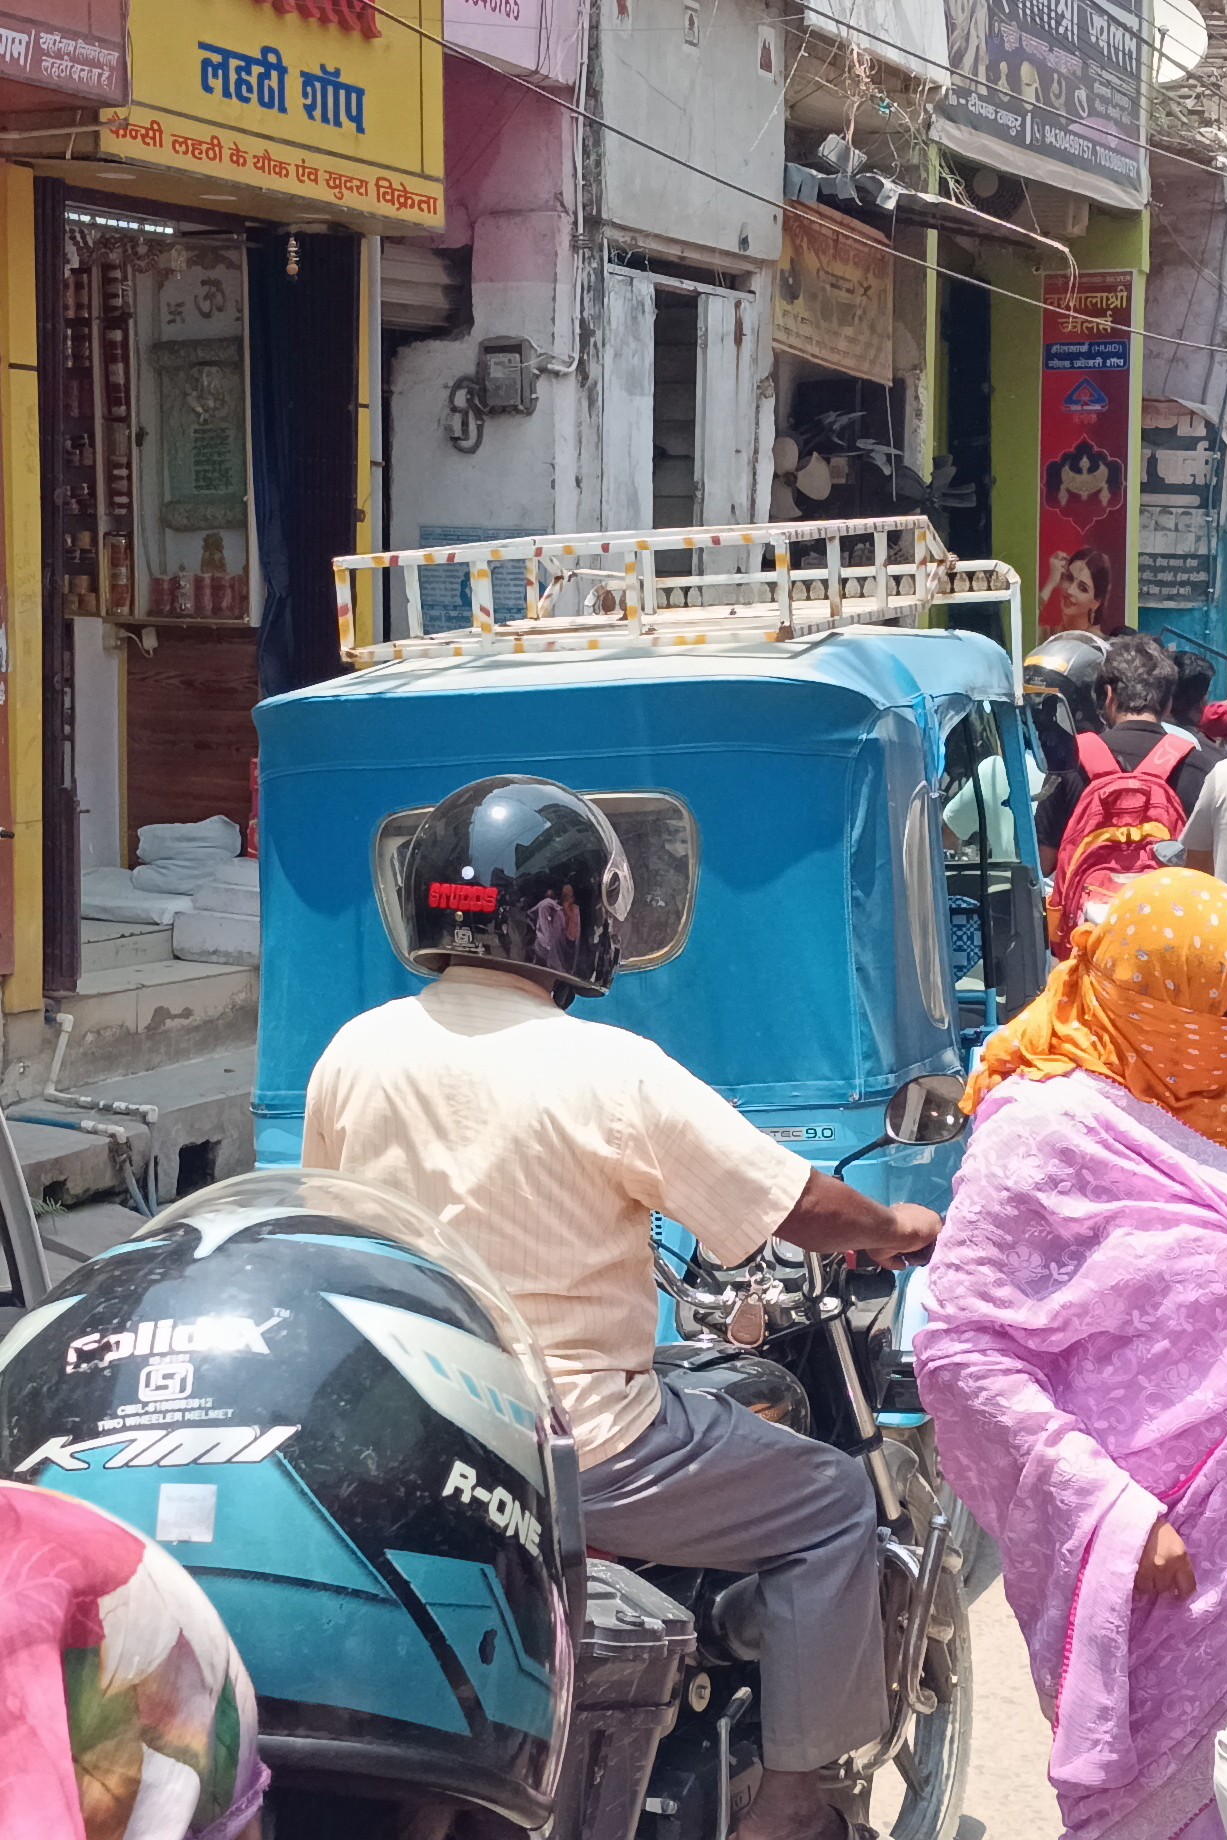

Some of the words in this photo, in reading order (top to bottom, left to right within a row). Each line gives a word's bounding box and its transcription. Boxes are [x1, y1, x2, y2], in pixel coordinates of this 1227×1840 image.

[197, 40, 289, 115] लहठी
[299, 63, 366, 135] शॉप
[967, 92, 996, 120] दीपक
[171, 135, 223, 163] लहठी
[228, 141, 248, 168] के
[323, 169, 369, 200] खुदरा
[374, 176, 437, 215] विक्रेता
[1091, 344, 1123, 353] (HUID)
[429, 882, 499, 913] STUDDS
[805, 1127, 834, 1139] 9.0
[98, 1418, 124, 1431] TWO
[125, 1411, 182, 1427] WHEELER
[184, 1408, 234, 1421] HELMET
[442, 1460, 542, 1557] R-ONE
